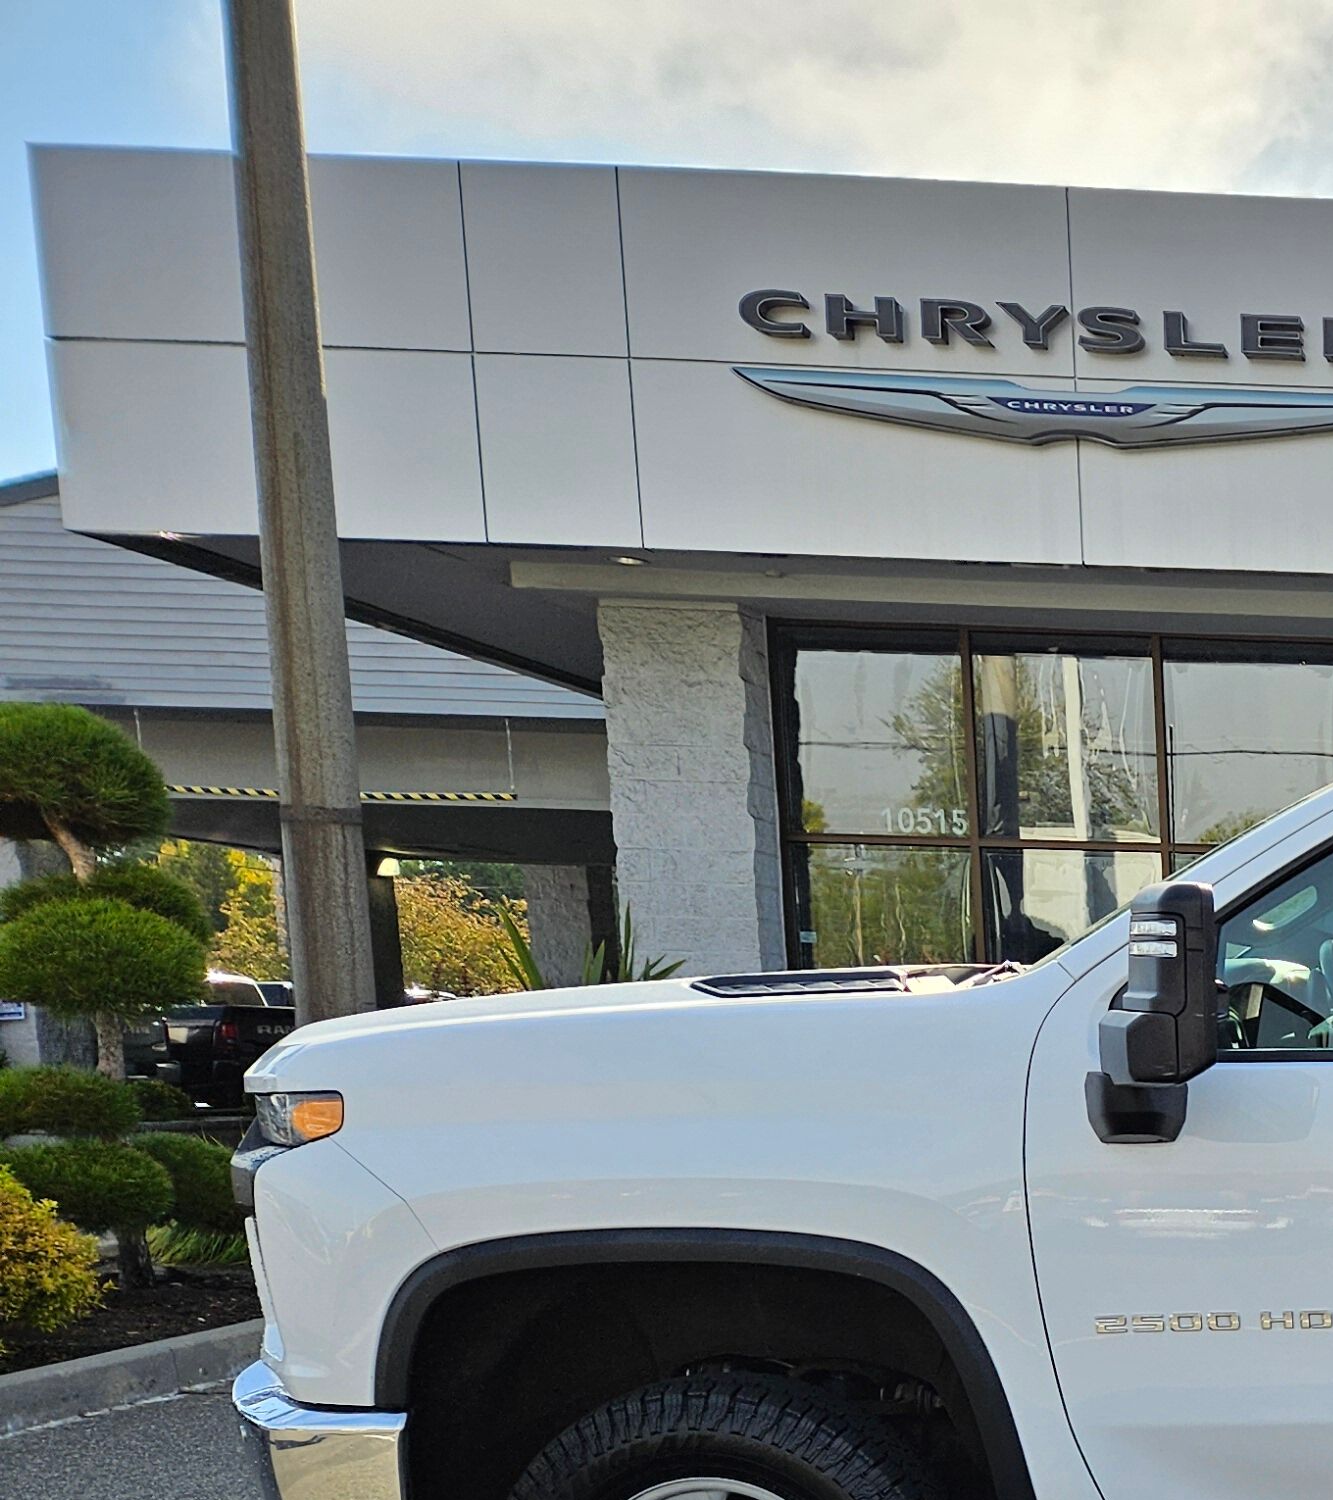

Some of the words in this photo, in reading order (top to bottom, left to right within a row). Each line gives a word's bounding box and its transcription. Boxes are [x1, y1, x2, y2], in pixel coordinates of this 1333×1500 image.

[1007, 400, 1134, 415] CHRYSLER
[881, 807, 969, 836] 10515
[1094, 1311, 1241, 1335] 2500
[1259, 1309, 1333, 1331] HD
